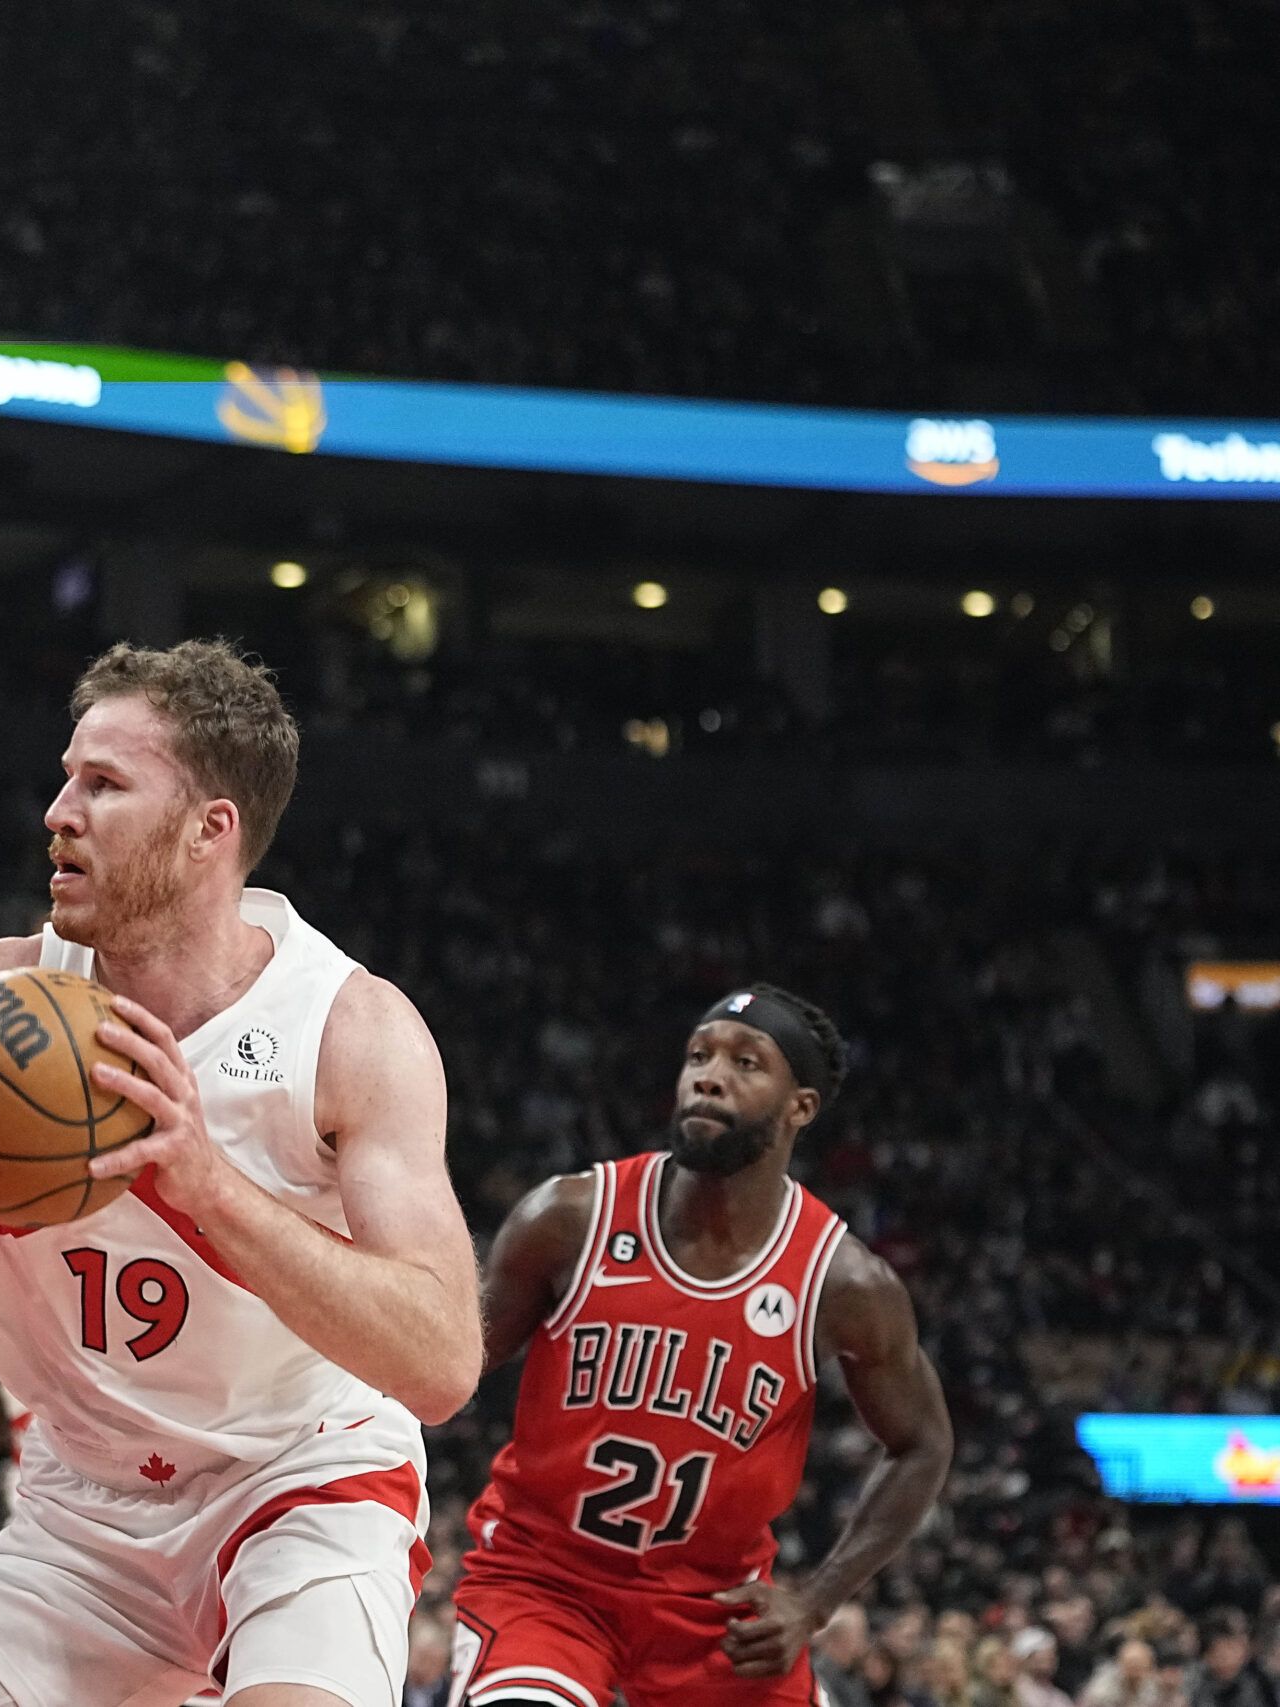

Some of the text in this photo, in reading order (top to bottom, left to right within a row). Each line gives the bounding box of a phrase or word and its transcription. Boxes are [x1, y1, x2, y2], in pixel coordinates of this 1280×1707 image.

[218, 1061, 284, 1083] Sun Life
[62, 1246, 190, 1363] 19
[611, 1233, 635, 1261] 6
[562, 1321, 785, 1452] BULLS
[572, 1433, 717, 1556] 21
